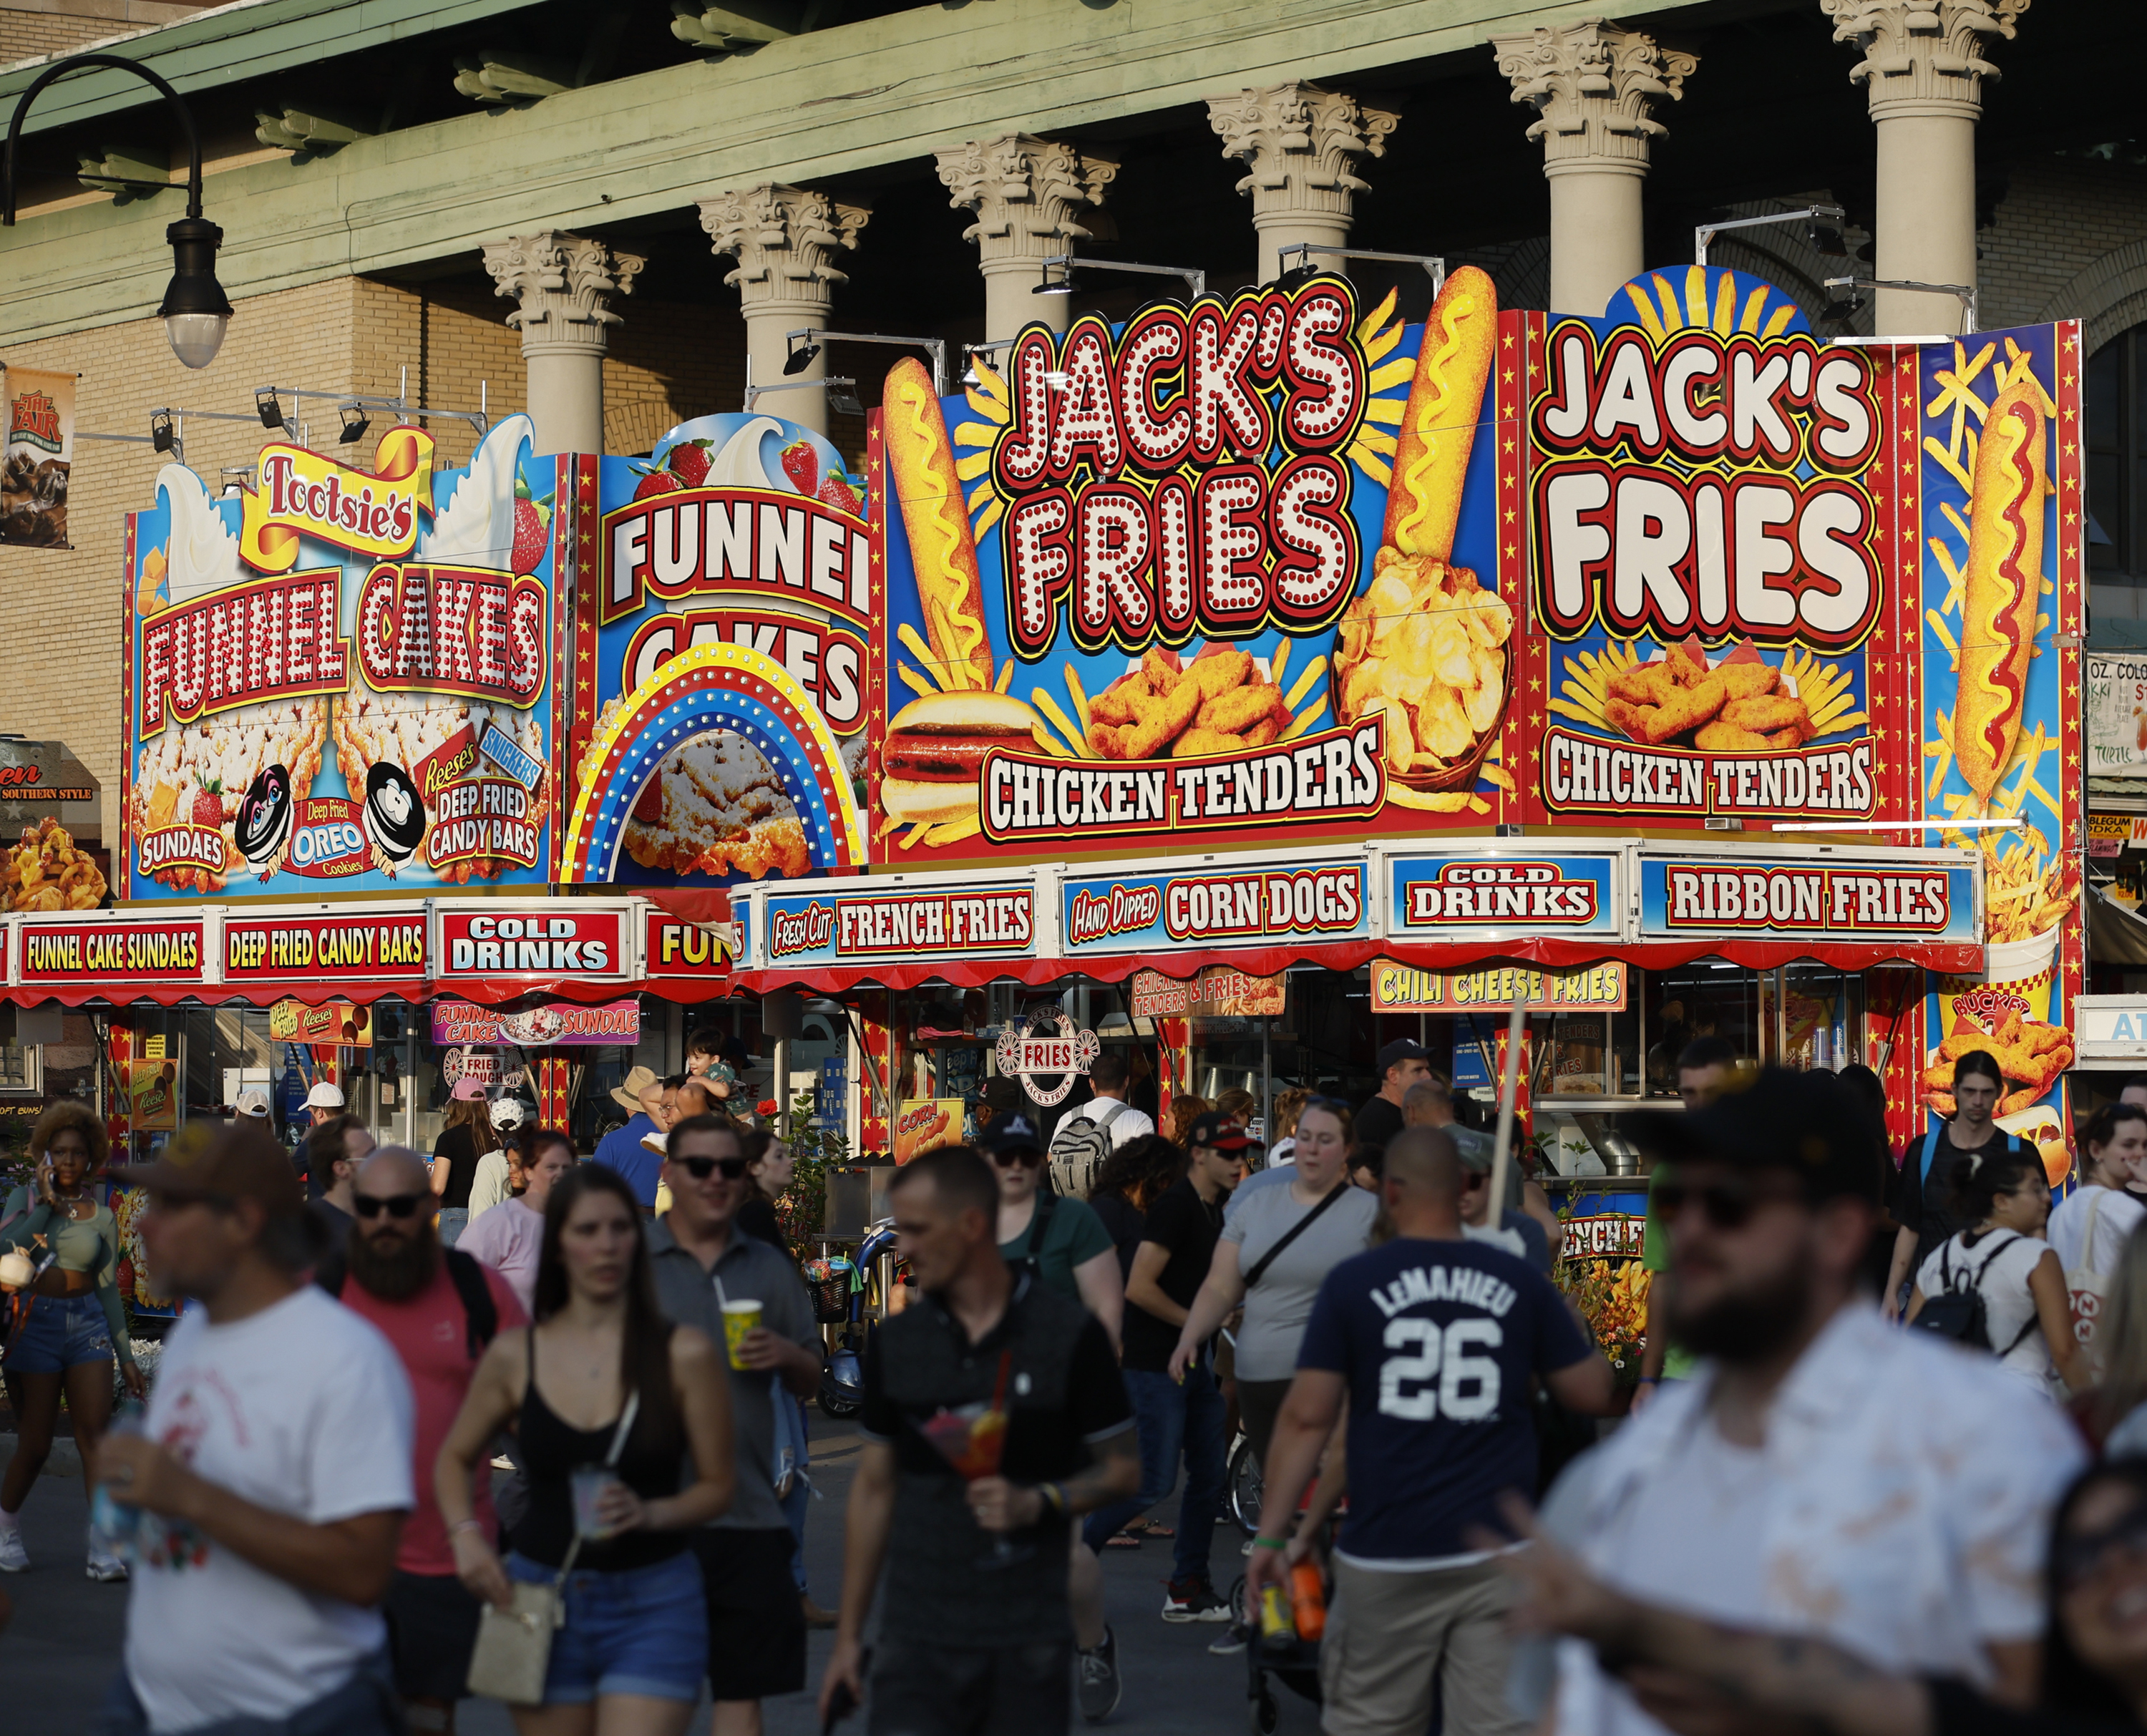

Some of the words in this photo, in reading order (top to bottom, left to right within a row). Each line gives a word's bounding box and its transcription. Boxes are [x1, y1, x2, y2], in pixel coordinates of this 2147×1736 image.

[21, 391, 54, 413] THE
[1005, 297, 1352, 477] JACK'S
[1546, 337, 1865, 458] JACK'S
[11, 401, 62, 442] FAIR
[263, 455, 413, 541] Tootsie's
[1013, 468, 1345, 635] FRIES
[1548, 474, 1866, 631] FRIES
[145, 582, 344, 725] FUNNEL
[361, 577, 537, 691] CAKES
[634, 621, 860, 721] CES
[2091, 663, 2111, 678] OZ.
[425, 743, 474, 797] Reese's
[482, 728, 539, 787] SNICKERS
[989, 760, 1166, 830] CHICKEN
[1176, 733, 1379, 819] TENDERS
[1551, 745, 1705, 804] CHICKEN
[1713, 749, 1871, 810] TENDERS
[2, 789, 57, 799] SOUTHERN
[59, 789, 92, 799] STYLE
[439, 786, 478, 819] DEEP
[482, 784, 526, 819] FRIED
[307, 801, 327, 822] Deep
[329, 800, 349, 819] Fried
[143, 831, 222, 869] SUNDAES
[293, 823, 364, 864] OREO
[431, 819, 488, 857] CANDY
[492, 819, 535, 859] BARS
[323, 862, 364, 876] Cookies
[1448, 868, 1554, 884] COLD
[1169, 881, 1260, 931] CORN
[1268, 874, 1358, 925] DOGS
[1413, 885, 1590, 917] DRINKS
[1673, 872, 1821, 921] RIBBON
[1831, 877, 1944, 924] FRIES
[469, 917, 576, 940] COLD
[839, 900, 945, 947] FRENCH
[950, 896, 1029, 942] FRIES
[27, 934, 82, 971] FUNNEL
[86, 932, 123, 970] CAKE
[127, 931, 198, 969] SUNDAES
[230, 930, 266, 968] DEEP
[271, 929, 313, 967] FRIED
[318, 927, 376, 966] CANDY
[380, 925, 422, 965] BARS
[452, 938, 609, 970] DRINKS
[1190, 979, 1201, 1003] &
[1204, 974, 1251, 1002] FRIES
[1378, 967, 1444, 1004] CHILI
[1452, 968, 1544, 1004] CHEESE
[1552, 967, 1620, 1003] FRIES
[271, 1001, 288, 1023] DEEP
[302, 1008, 333, 1028] Reese's
[435, 1005, 507, 1025] FUNNEL
[1134, 991, 1187, 1016] TENDERS
[1953, 993, 2030, 1015] BUCKET
[279, 1016, 298, 1040] FRIED
[446, 1024, 497, 1043] CAKE
[563, 1009, 638, 1035] SUNDAE
[1026, 1007, 1049, 1033] JACK'S
[1051, 1009, 1070, 1032] FRIES
[1557, 1025, 1600, 1040] TENDERS
[147, 1061, 161, 1081] FRIED
[467, 1059, 500, 1070] FRIED
[948, 1053, 967, 1071] eep
[1024, 1043, 1071, 1069] FRIES
[1026, 1081, 1049, 1103] JACK'S
[1051, 1079, 1071, 1103] FRIES
[18, 1105, 43, 1115] BUNS!
[898, 1100, 938, 1135] CORN
[1378, 1317, 1503, 1421] 26
